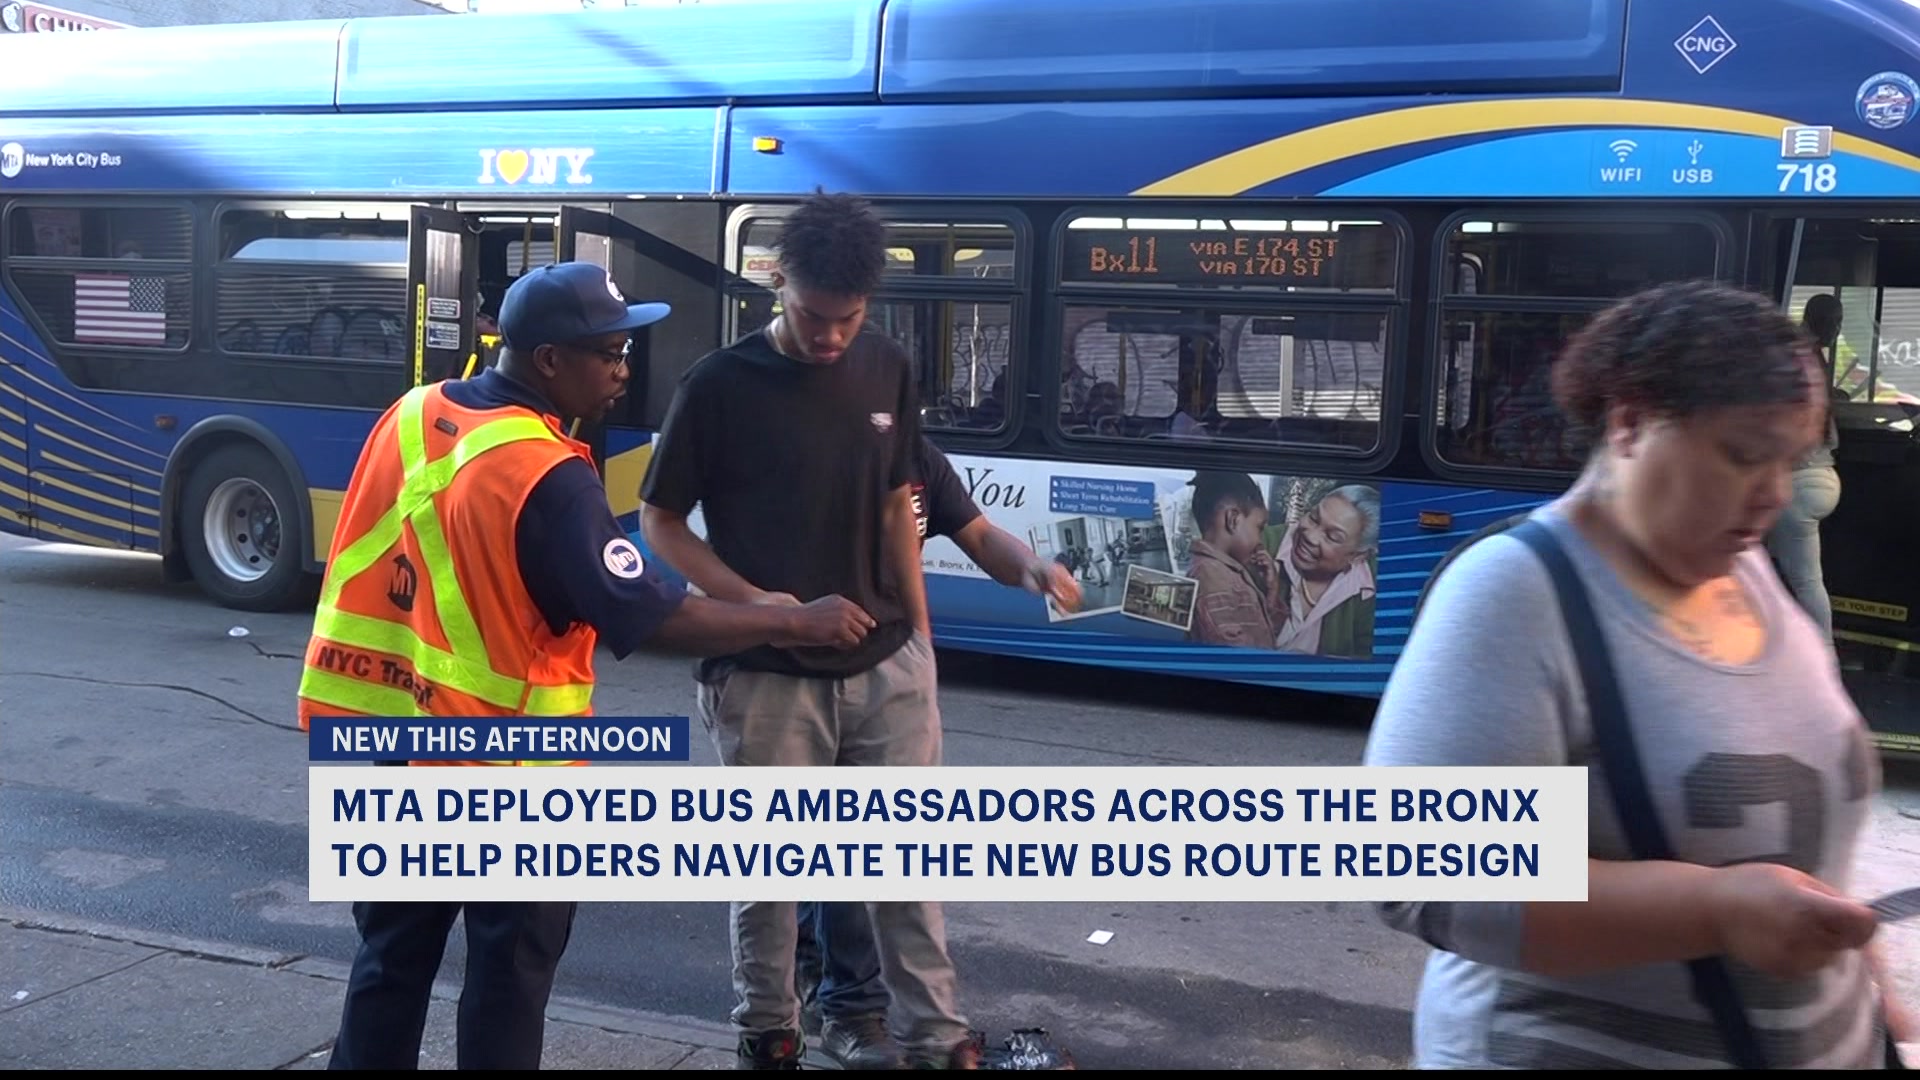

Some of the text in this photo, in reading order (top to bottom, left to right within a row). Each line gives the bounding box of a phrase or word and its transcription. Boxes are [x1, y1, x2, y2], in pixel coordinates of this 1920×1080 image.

[1682, 36, 1726, 53] CNG
[26, 152, 122, 169] New York City Bus
[477, 148, 497, 184] I
[1600, 167, 1641, 182] WIFI
[1672, 169, 1713, 183] USB
[1776, 163, 1837, 193] 718
[1090, 236, 1158, 273] Bx11
[1189, 237, 1339, 258] VIA E 174 ST
[1200, 257, 1323, 276] VIA 170 ST
[964, 466, 1026, 509] You
[1060, 479, 1138, 493] Skilled Nursing Home
[1060, 490, 1080, 500] Short
[1081, 492, 1099, 502] Term
[1060, 501, 1117, 514] Long Term Care
[1878, 606, 1905, 617] STEP
[317, 646, 372, 678] NYC
